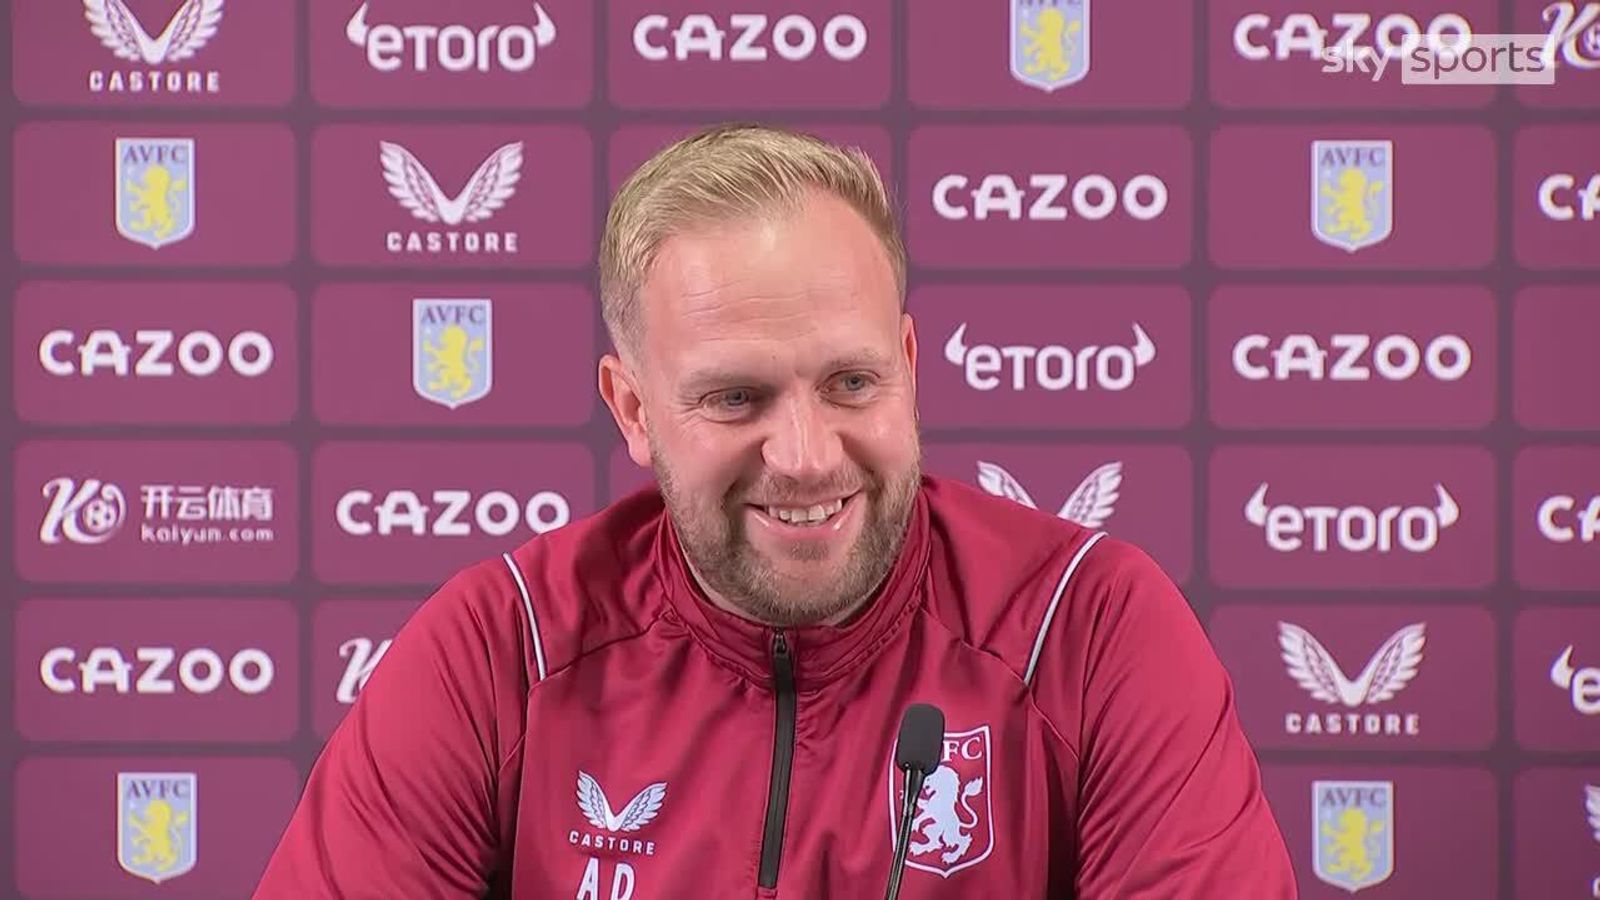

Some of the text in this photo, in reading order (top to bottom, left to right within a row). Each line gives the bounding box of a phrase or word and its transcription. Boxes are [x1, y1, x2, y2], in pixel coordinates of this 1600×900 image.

[634, 14, 867, 60] CAZOO
[1234, 14, 1472, 60] CAZOO
[90, 72, 220, 92] CASTORE
[123, 145, 188, 163] AVFC
[1320, 147, 1386, 166] AVFC
[933, 174, 1168, 220] CAZOO
[387, 233, 518, 252] CASTORE
[421, 305, 486, 323] AVFC
[39, 330, 273, 376] CAZOO
[1232, 335, 1471, 380] CAZOO
[141, 486, 273, 520] 开云体育
[336, 490, 570, 536] CAZOO
[141, 524, 273, 545] kaiyun.com
[40, 648, 274, 694] CAZOO
[1286, 714, 1419, 734] CASTORE
[942, 736, 983, 762] FC
[126, 780, 191, 799] AVFC
[1320, 787, 1386, 807] AVFC
[569, 830, 655, 855] CASTORE
